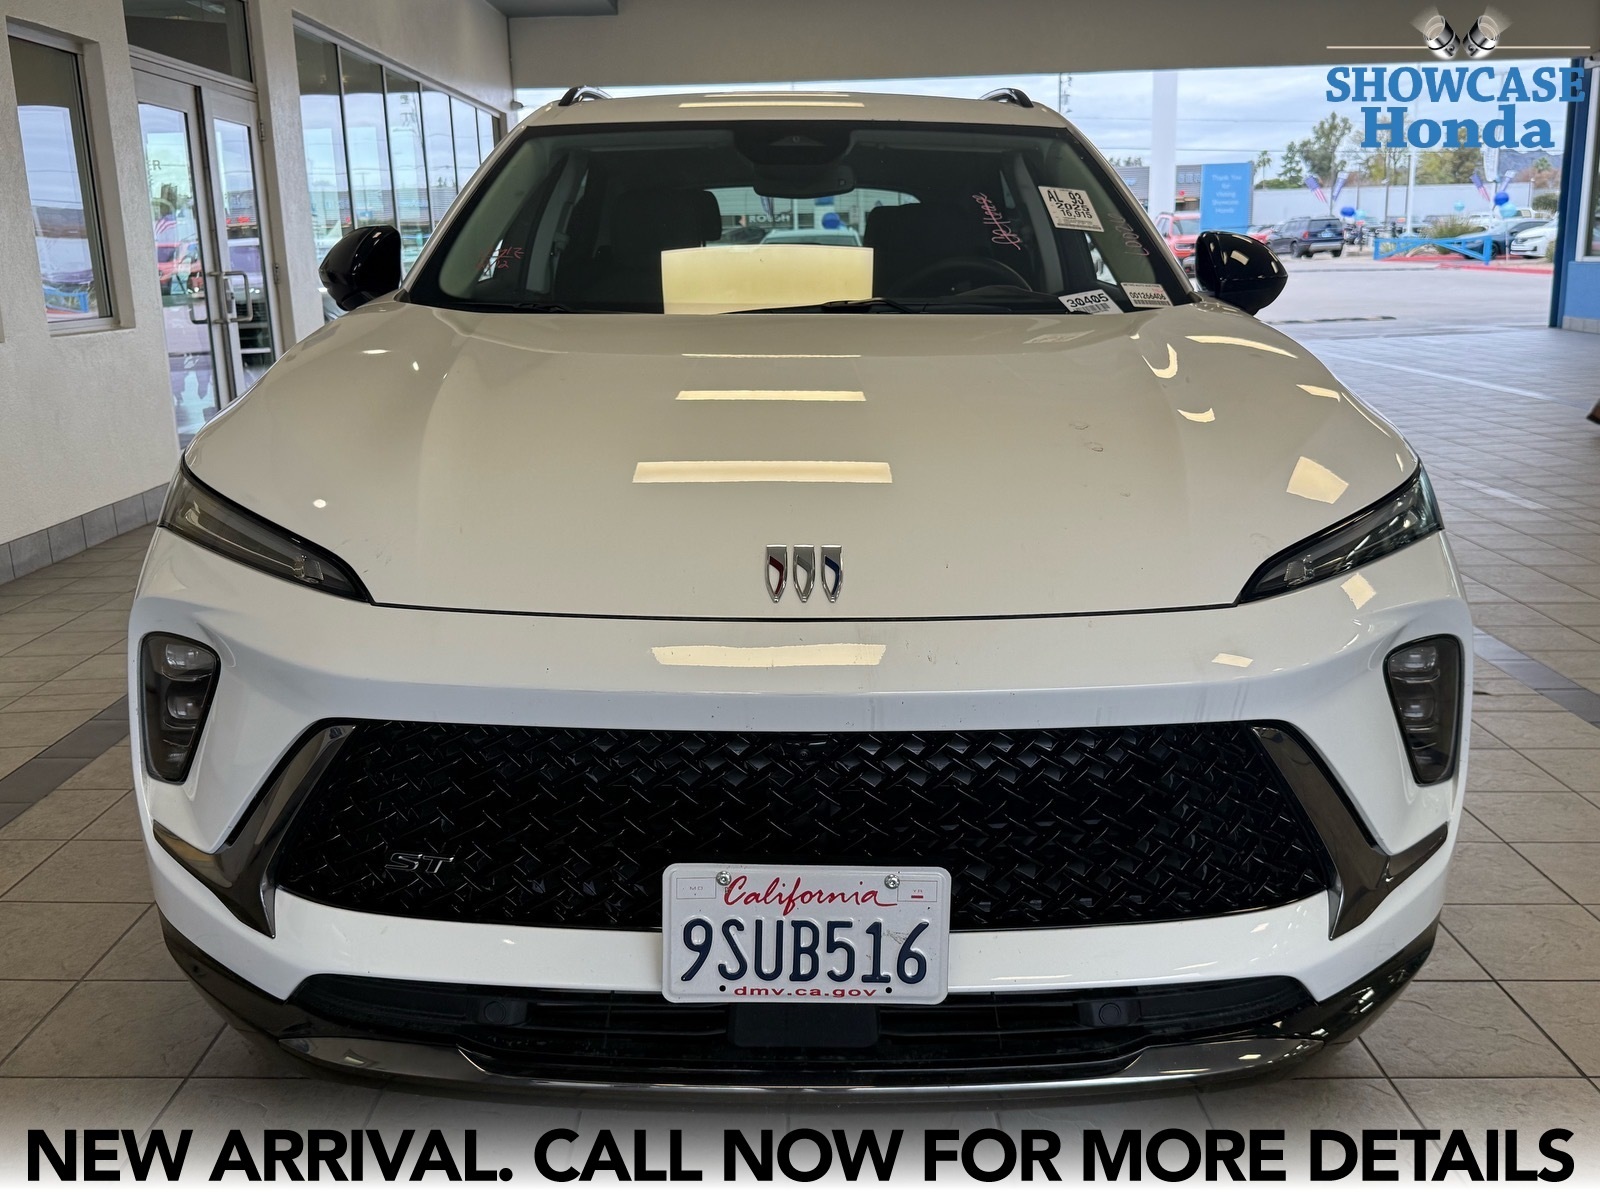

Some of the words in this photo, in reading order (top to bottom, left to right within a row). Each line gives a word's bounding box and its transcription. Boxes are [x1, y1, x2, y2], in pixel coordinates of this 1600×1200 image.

[1047, 190, 1063, 203] AL
[1068, 191, 1084, 205] 93
[1055, 202, 1089, 212] 2025
[1067, 293, 1109, 308] 30405
[385, 853, 454, 873] ST
[723, 875, 898, 916] California
[681, 918, 929, 984] 9SUB516
[734, 986, 877, 998] dmv.ca.gov
